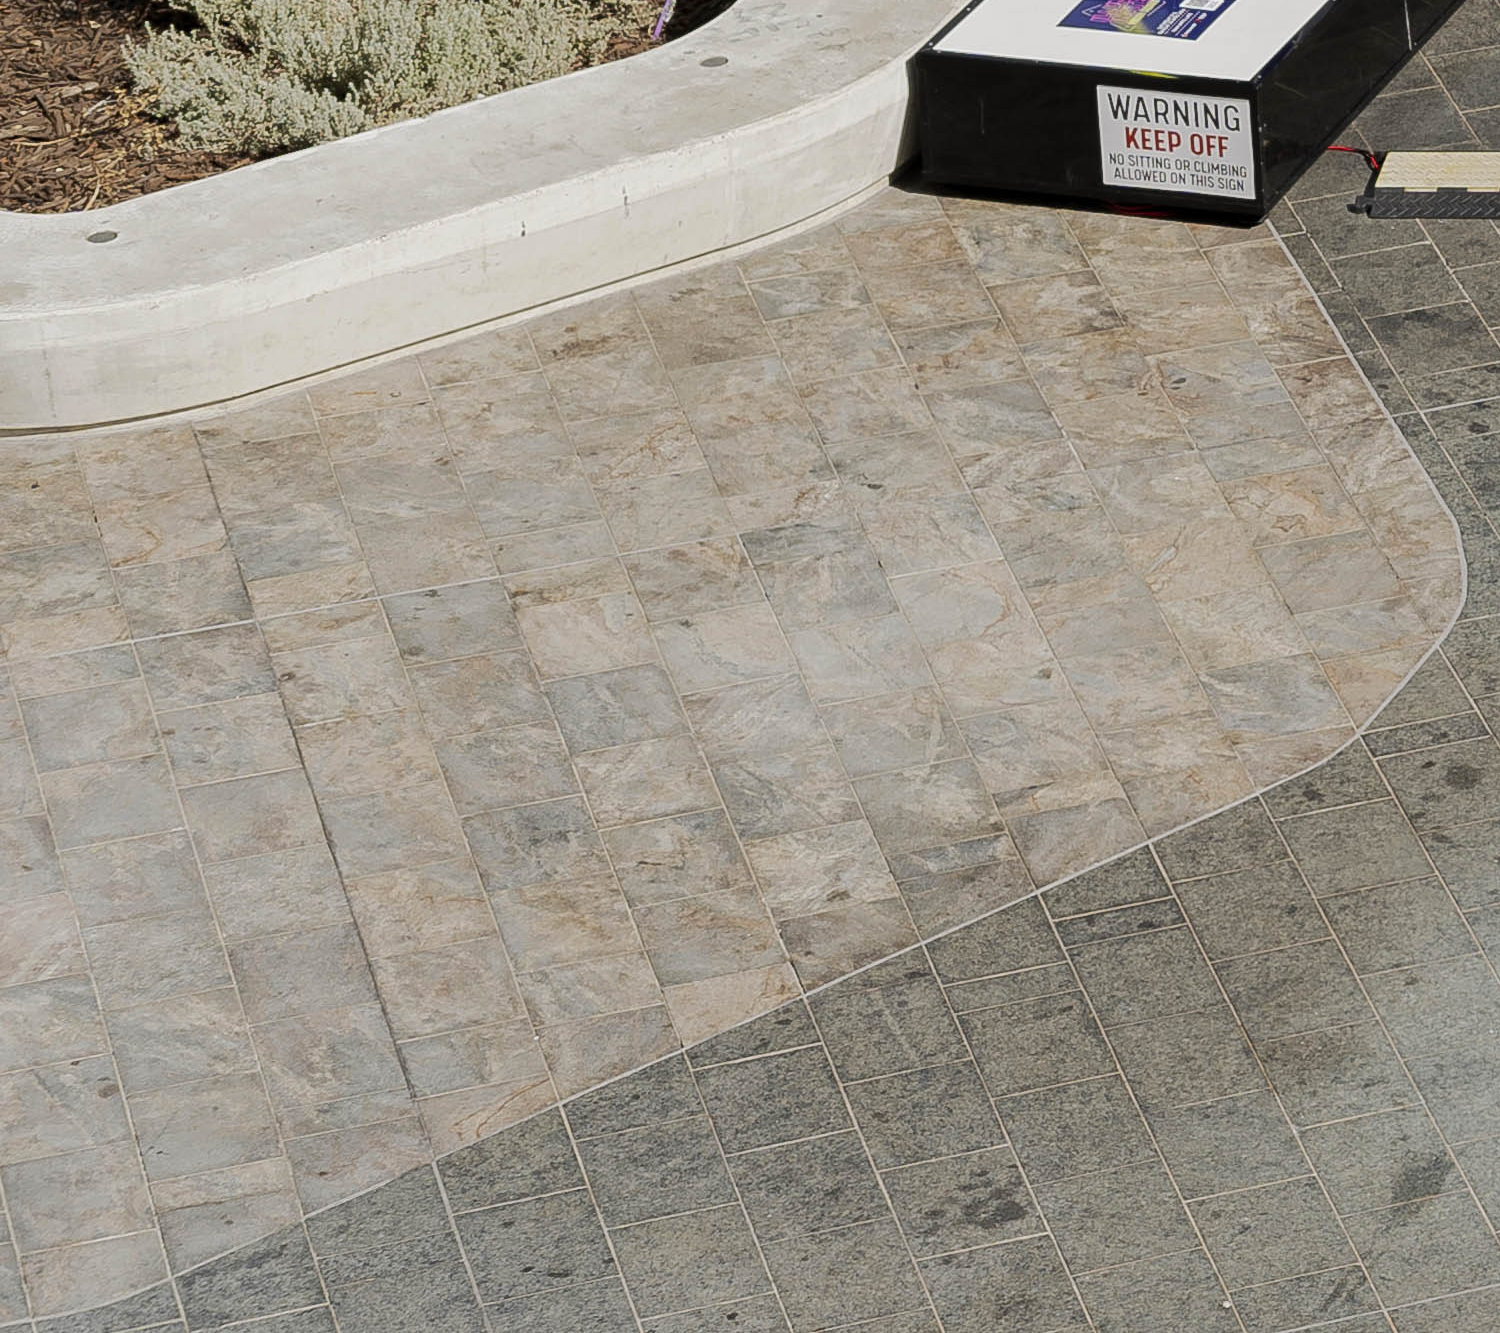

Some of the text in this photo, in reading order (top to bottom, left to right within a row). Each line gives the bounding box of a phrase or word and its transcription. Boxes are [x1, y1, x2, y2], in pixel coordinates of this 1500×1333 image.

[1108, 92, 1240, 132] WARNING
[1125, 126, 1229, 158] KEEP OFF
[1109, 153, 1247, 178] NO SITTING OR CLIMBING
[1114, 168, 1244, 191] ALLOWED ON THIS SIGN
